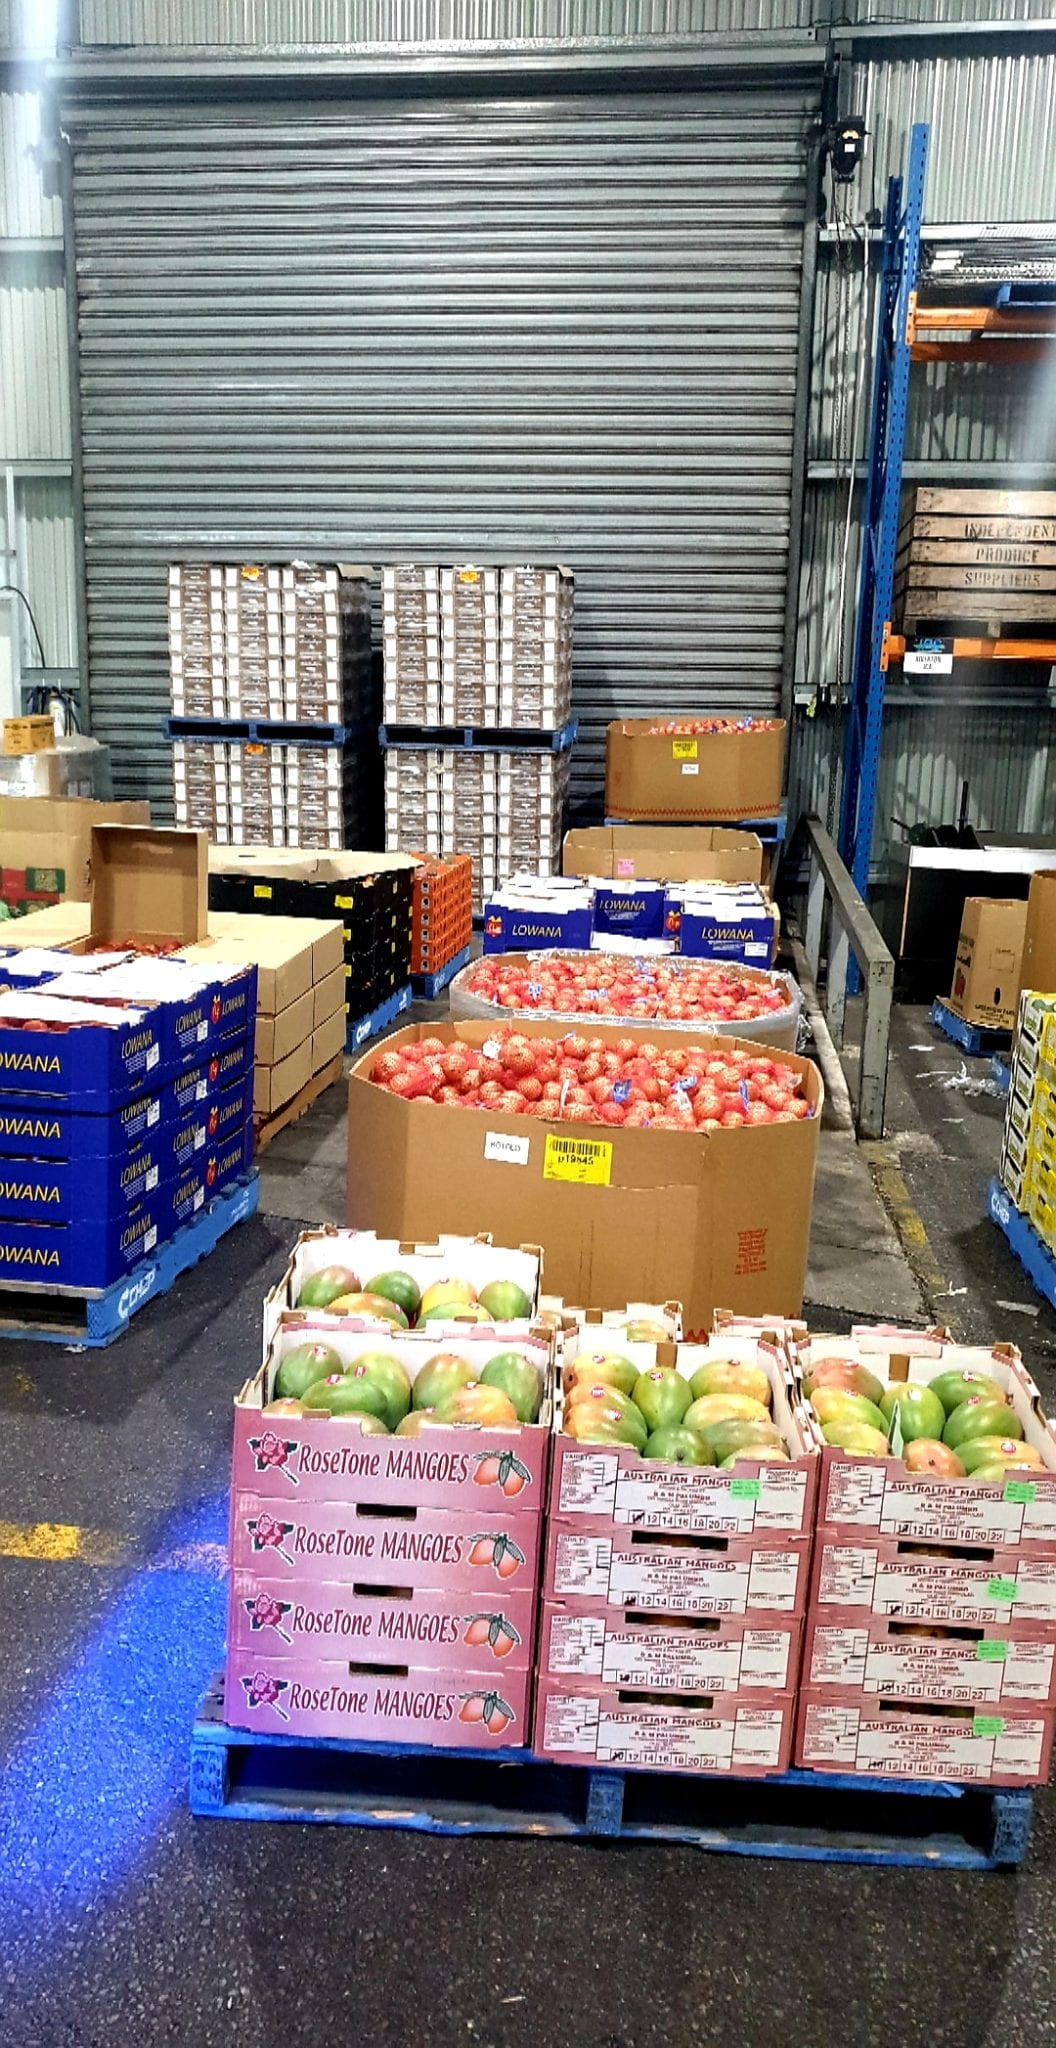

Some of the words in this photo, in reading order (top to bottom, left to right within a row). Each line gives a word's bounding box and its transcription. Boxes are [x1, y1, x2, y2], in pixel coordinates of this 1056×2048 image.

[976, 548, 1040, 562] PRODUCE
[965, 572, 1040, 587] SUPPLIERS
[600, 900, 646, 912] LOWANA
[511, 925, 562, 938] LOWANA
[701, 927, 754, 940] LOWANA
[0, 1051, 61, 1074] WANA
[0, 1118, 61, 1139] WANA
[0, 1183, 61, 1203] WANA
[0, 1246, 60, 1267] WANA
[299, 1445, 379, 1476] RoseTone
[385, 1450, 470, 1483] MANGOES
[624, 1471, 687, 1484] AUSTRALIAN
[693, 1477, 731, 1488] MANGO
[891, 1484, 955, 1495] AUSTRALIAN
[294, 1526, 375, 1557] RoseTone
[381, 1531, 464, 1564] MANGOES
[618, 1555, 681, 1566] AUSTRALIAN
[686, 1560, 736, 1570] MANGOES
[883, 1564, 946, 1576] AUSTRALIAN
[292, 1606, 371, 1636] RoseTone
[378, 1611, 460, 1643] MANGOES
[611, 1634, 674, 1645] AUSTRALIAN
[679, 1639, 728, 1649] MANGOES
[874, 1645, 937, 1656] AUSTRALIAN
[290, 1683, 367, 1713] RoseTone
[374, 1689, 456, 1721] MANGOES
[605, 1714, 667, 1724] AUSTRALIAN
[673, 1718, 721, 1728] MANGOES
[866, 1723, 928, 1733] AUSTRALIAN
[933, 1728, 974, 1736] MANGO
